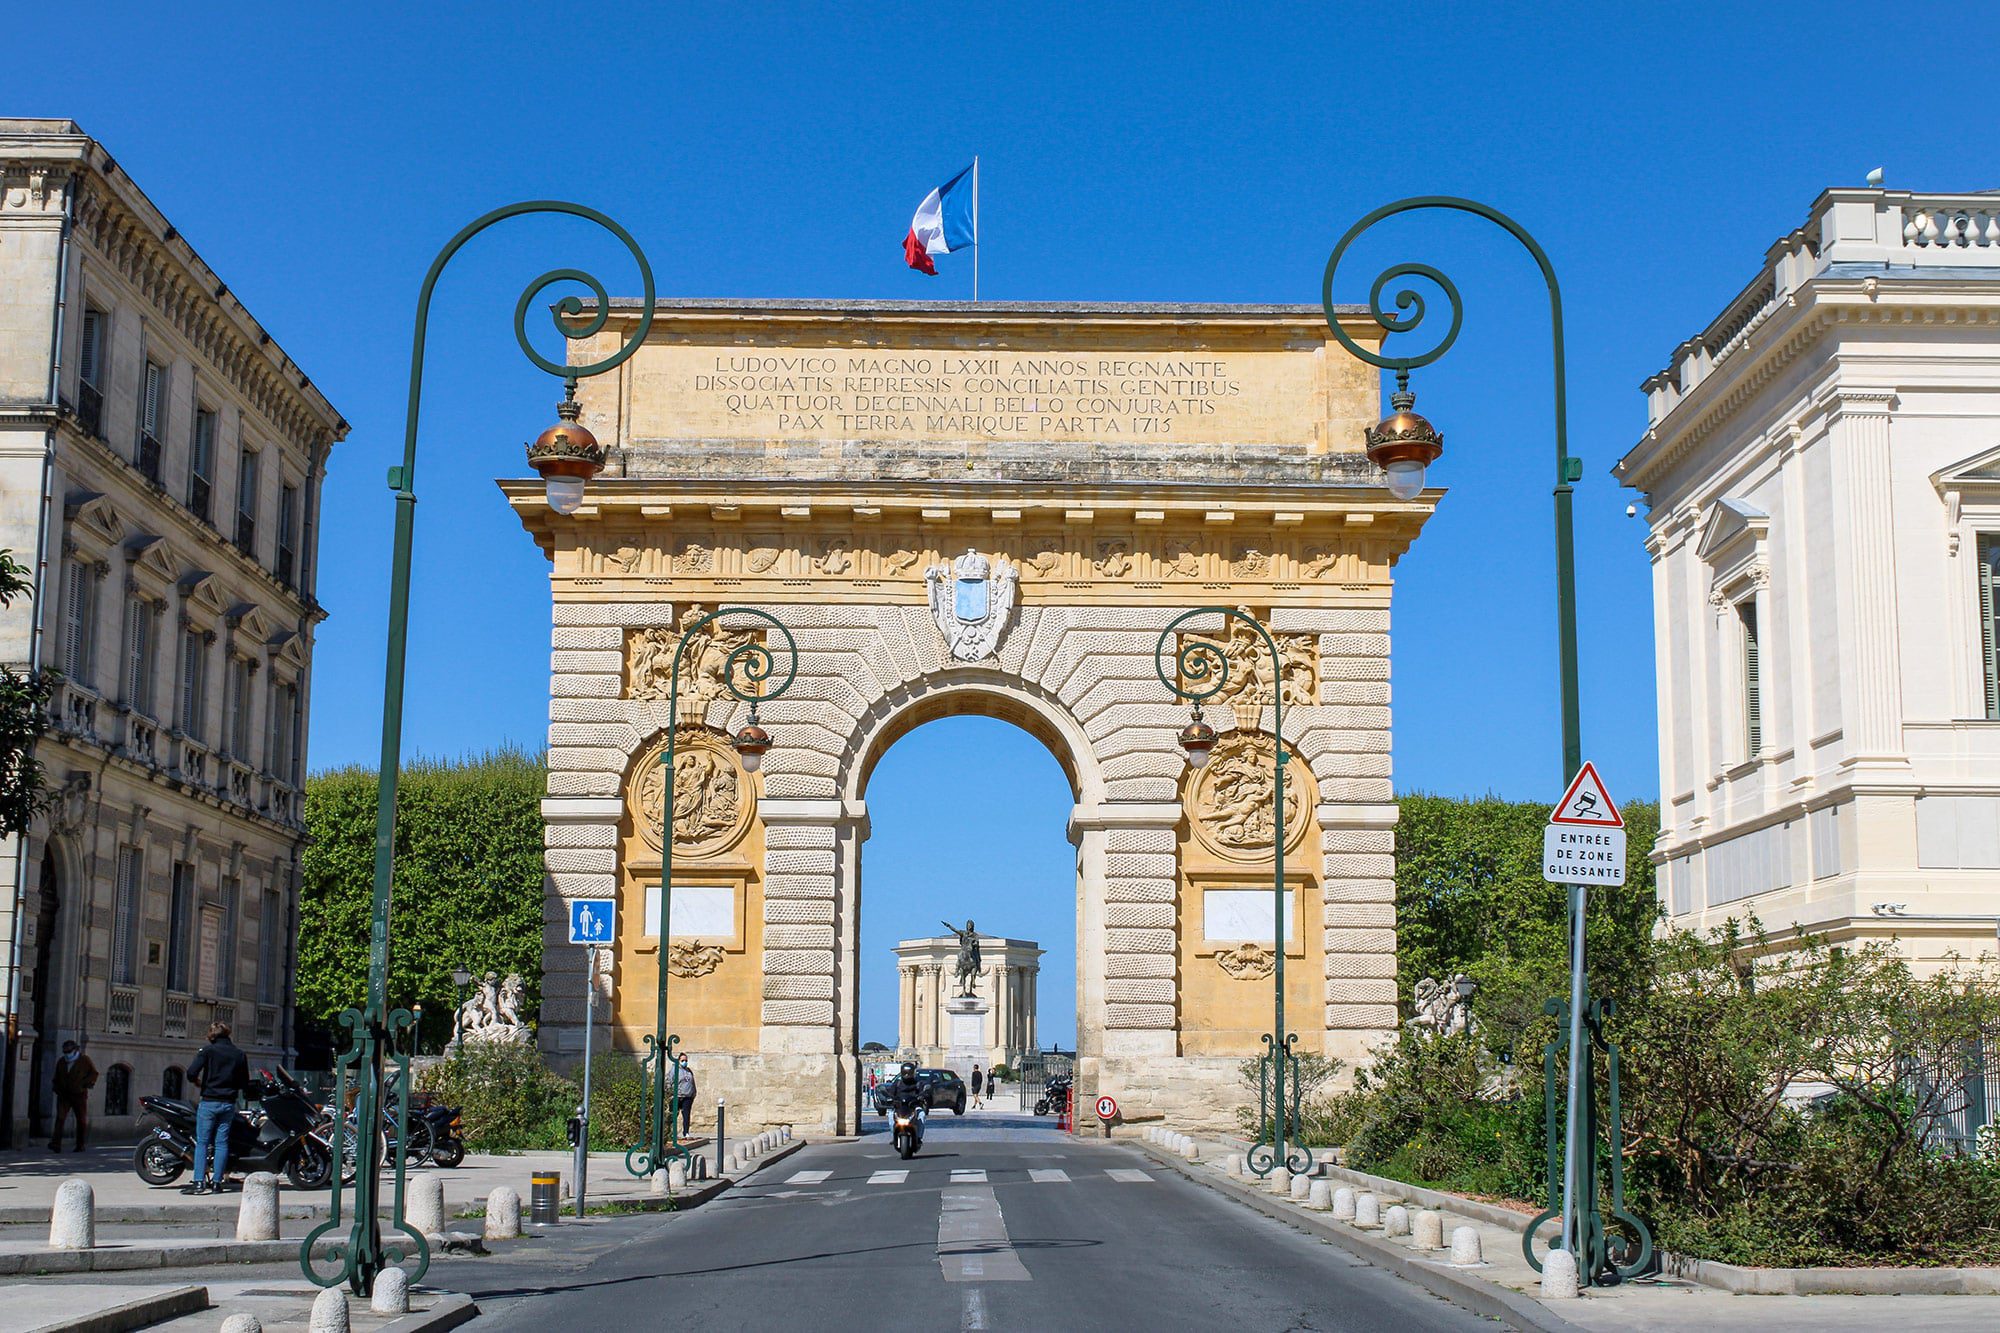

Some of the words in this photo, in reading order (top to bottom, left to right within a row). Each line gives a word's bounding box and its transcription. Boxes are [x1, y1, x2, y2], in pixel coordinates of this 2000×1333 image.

[715, 357, 837, 374] LUDOVICO
[848, 358, 932, 375] MAGNO
[943, 359, 999, 375] LXXII
[1011, 360, 1088, 376] ANNOS
[1098, 361, 1227, 378] REGNANTE
[695, 375, 833, 392] DISSOCIATIS
[844, 377, 952, 393] REPRESSIS
[964, 378, 1109, 395] CONCILIATIS
[1120, 380, 1240, 396] GENTIBUS
[726, 395, 843, 414] QUATUOR
[855, 396, 983, 413] DECENNALI
[994, 397, 1064, 413] BELLO
[1076, 398, 1216, 415] CONJURATIS
[778, 414, 824, 430] PAX
[836, 414, 914, 431] TERRA
[926, 415, 1029, 436] MARIQUE
[1040, 416, 1121, 433] PARTA
[1132, 417, 1172, 433] 1715
[1560, 833, 1611, 846] ENTRÉE
[1557, 849, 1573, 859] DE
[1580, 850, 1613, 862] ZONE
[1549, 865, 1621, 878] GLISSANTE
